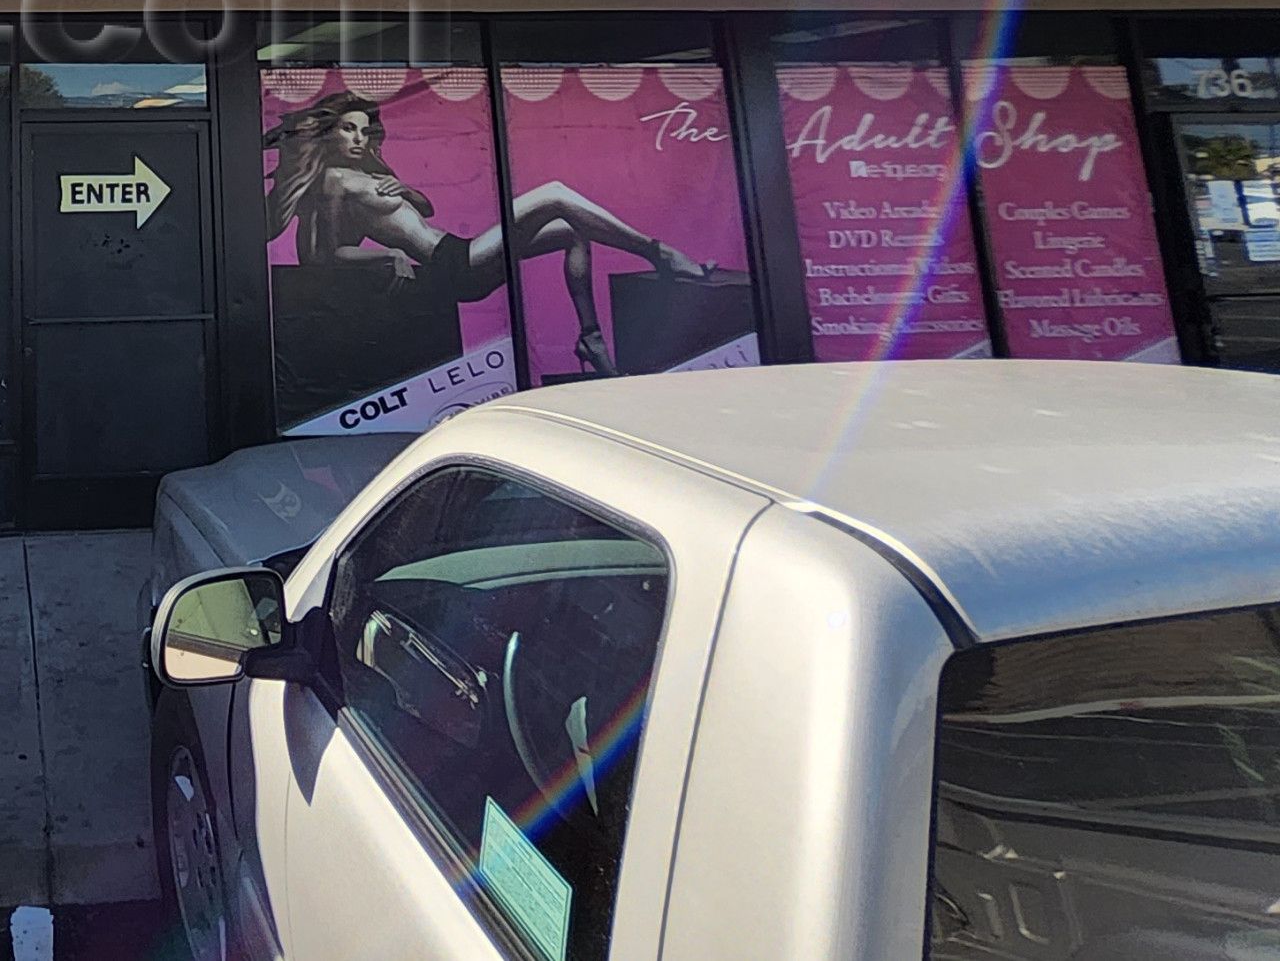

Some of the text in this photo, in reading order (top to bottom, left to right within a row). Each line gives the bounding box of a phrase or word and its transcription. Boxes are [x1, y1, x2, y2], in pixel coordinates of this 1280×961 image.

[639, 100, 1123, 182] The Adult Shop
[70, 182, 151, 205] ENTER
[828, 230, 878, 249] DVD
[339, 387, 409, 429] COLT
[428, 350, 505, 394] LELO
